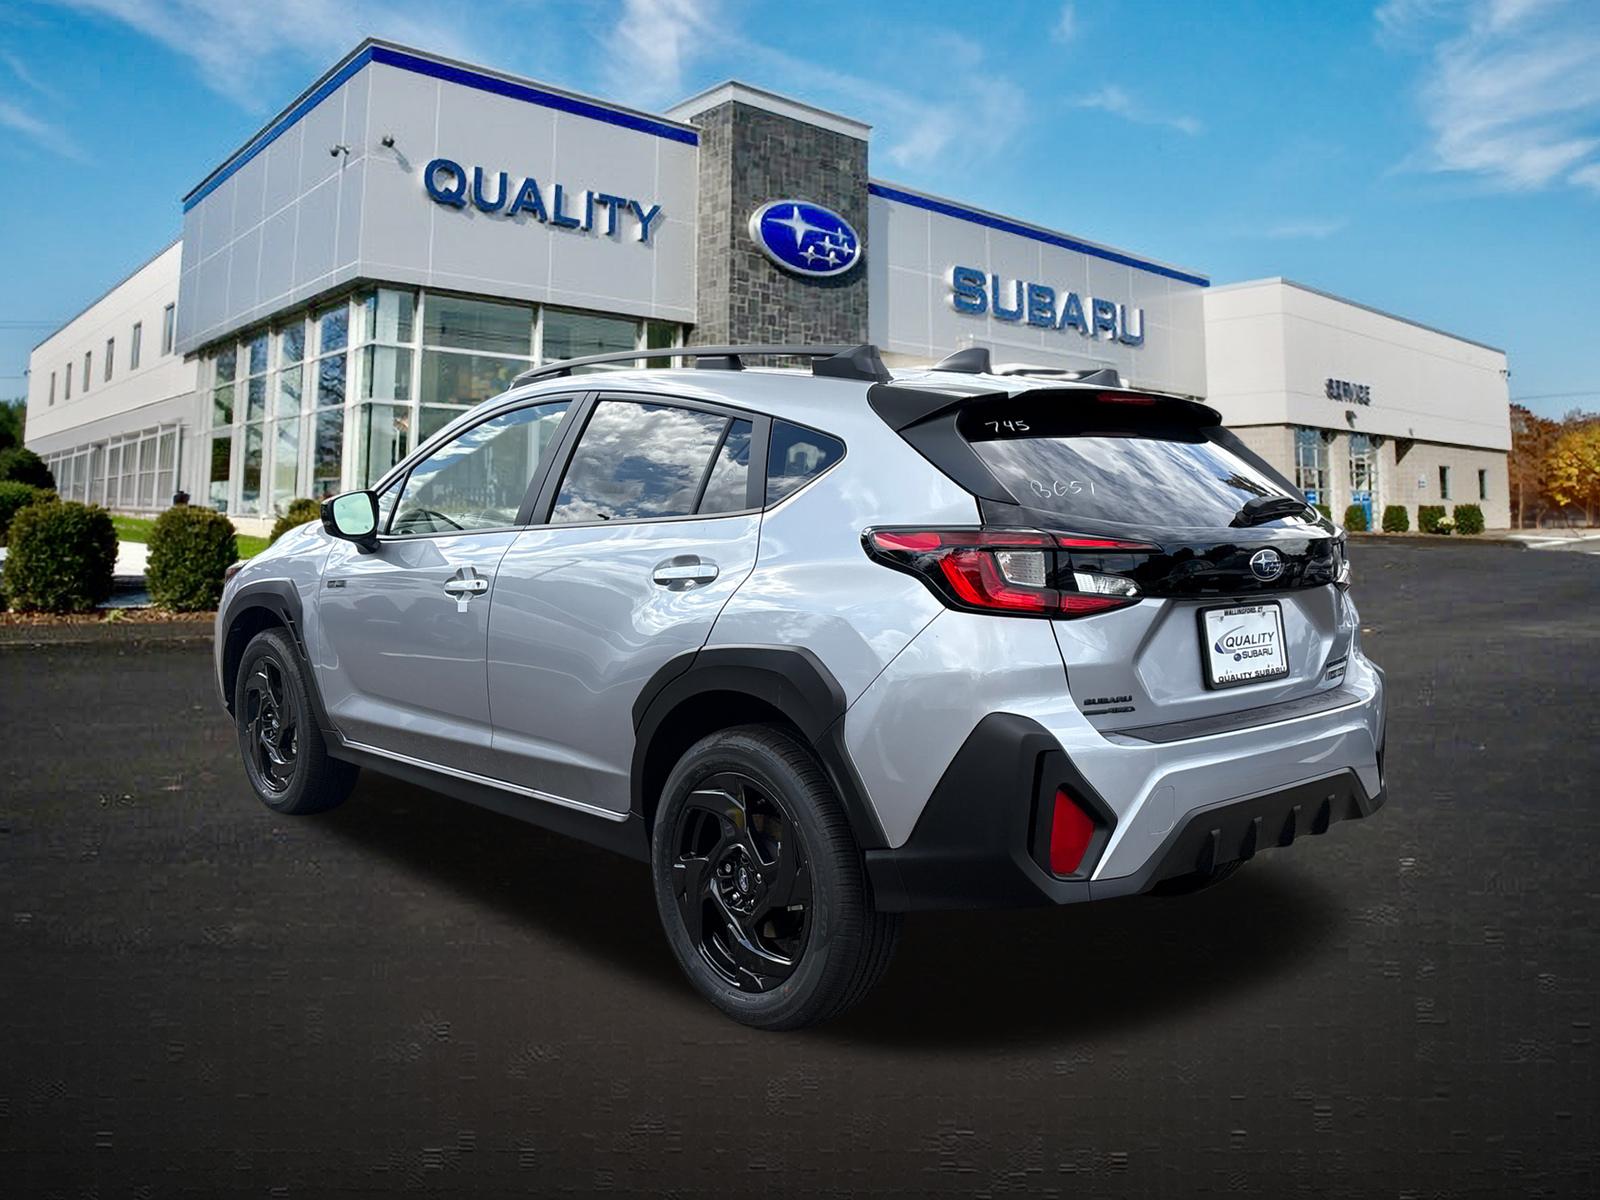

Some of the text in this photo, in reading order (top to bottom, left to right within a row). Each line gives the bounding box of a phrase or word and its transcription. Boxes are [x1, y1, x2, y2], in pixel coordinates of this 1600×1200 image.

[423, 158, 662, 243] QUALITY
[951, 265, 1146, 346] SUBARU
[1325, 378, 1371, 406] SERVICE
[984, 419, 1030, 433] 745
[1226, 632, 1274, 648] QUALITY
[1242, 647, 1273, 659] SUBARU
[1218, 666, 1286, 683] QUALITY SUBARU
[1083, 695, 1132, 706] SUBARU
